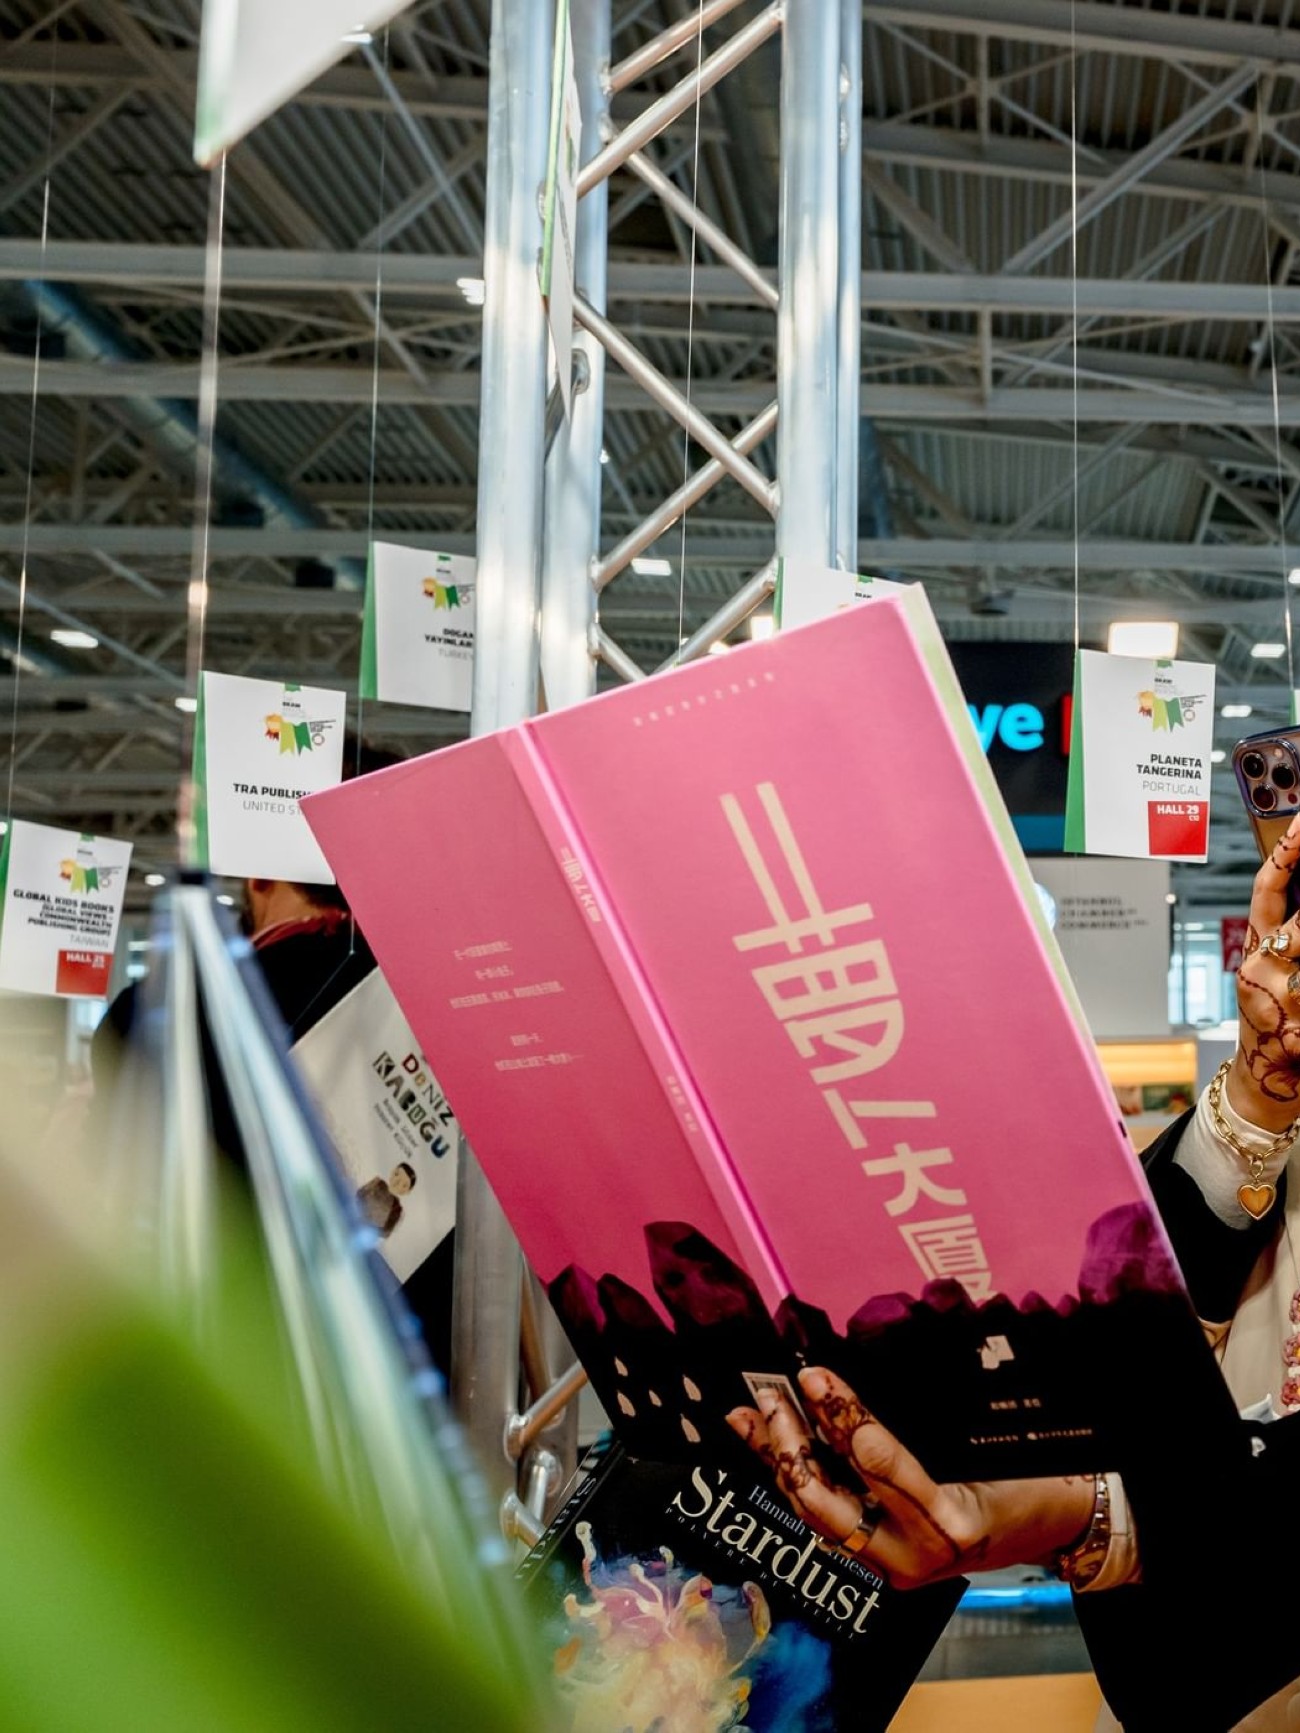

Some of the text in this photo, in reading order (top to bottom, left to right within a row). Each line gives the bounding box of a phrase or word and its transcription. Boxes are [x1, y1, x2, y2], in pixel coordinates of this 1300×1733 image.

[1150, 753, 1202, 768] PLANETA
[1136, 763, 1202, 780] TANGERINA
[233, 783, 258, 795] TRA
[1142, 780, 1201, 796] PORTUGAL
[242, 800, 286, 814] UNITED
[1157, 804, 1199, 815] HALL 29
[13, 889, 51, 903] GLOBAL
[54, 897, 79, 908] KIDS
[70, 934, 109, 948] TAIWAN
[66, 952, 92, 963] HALL
[748, 1484, 807, 1537] Hannah
[671, 1465, 881, 1635] Stardust
